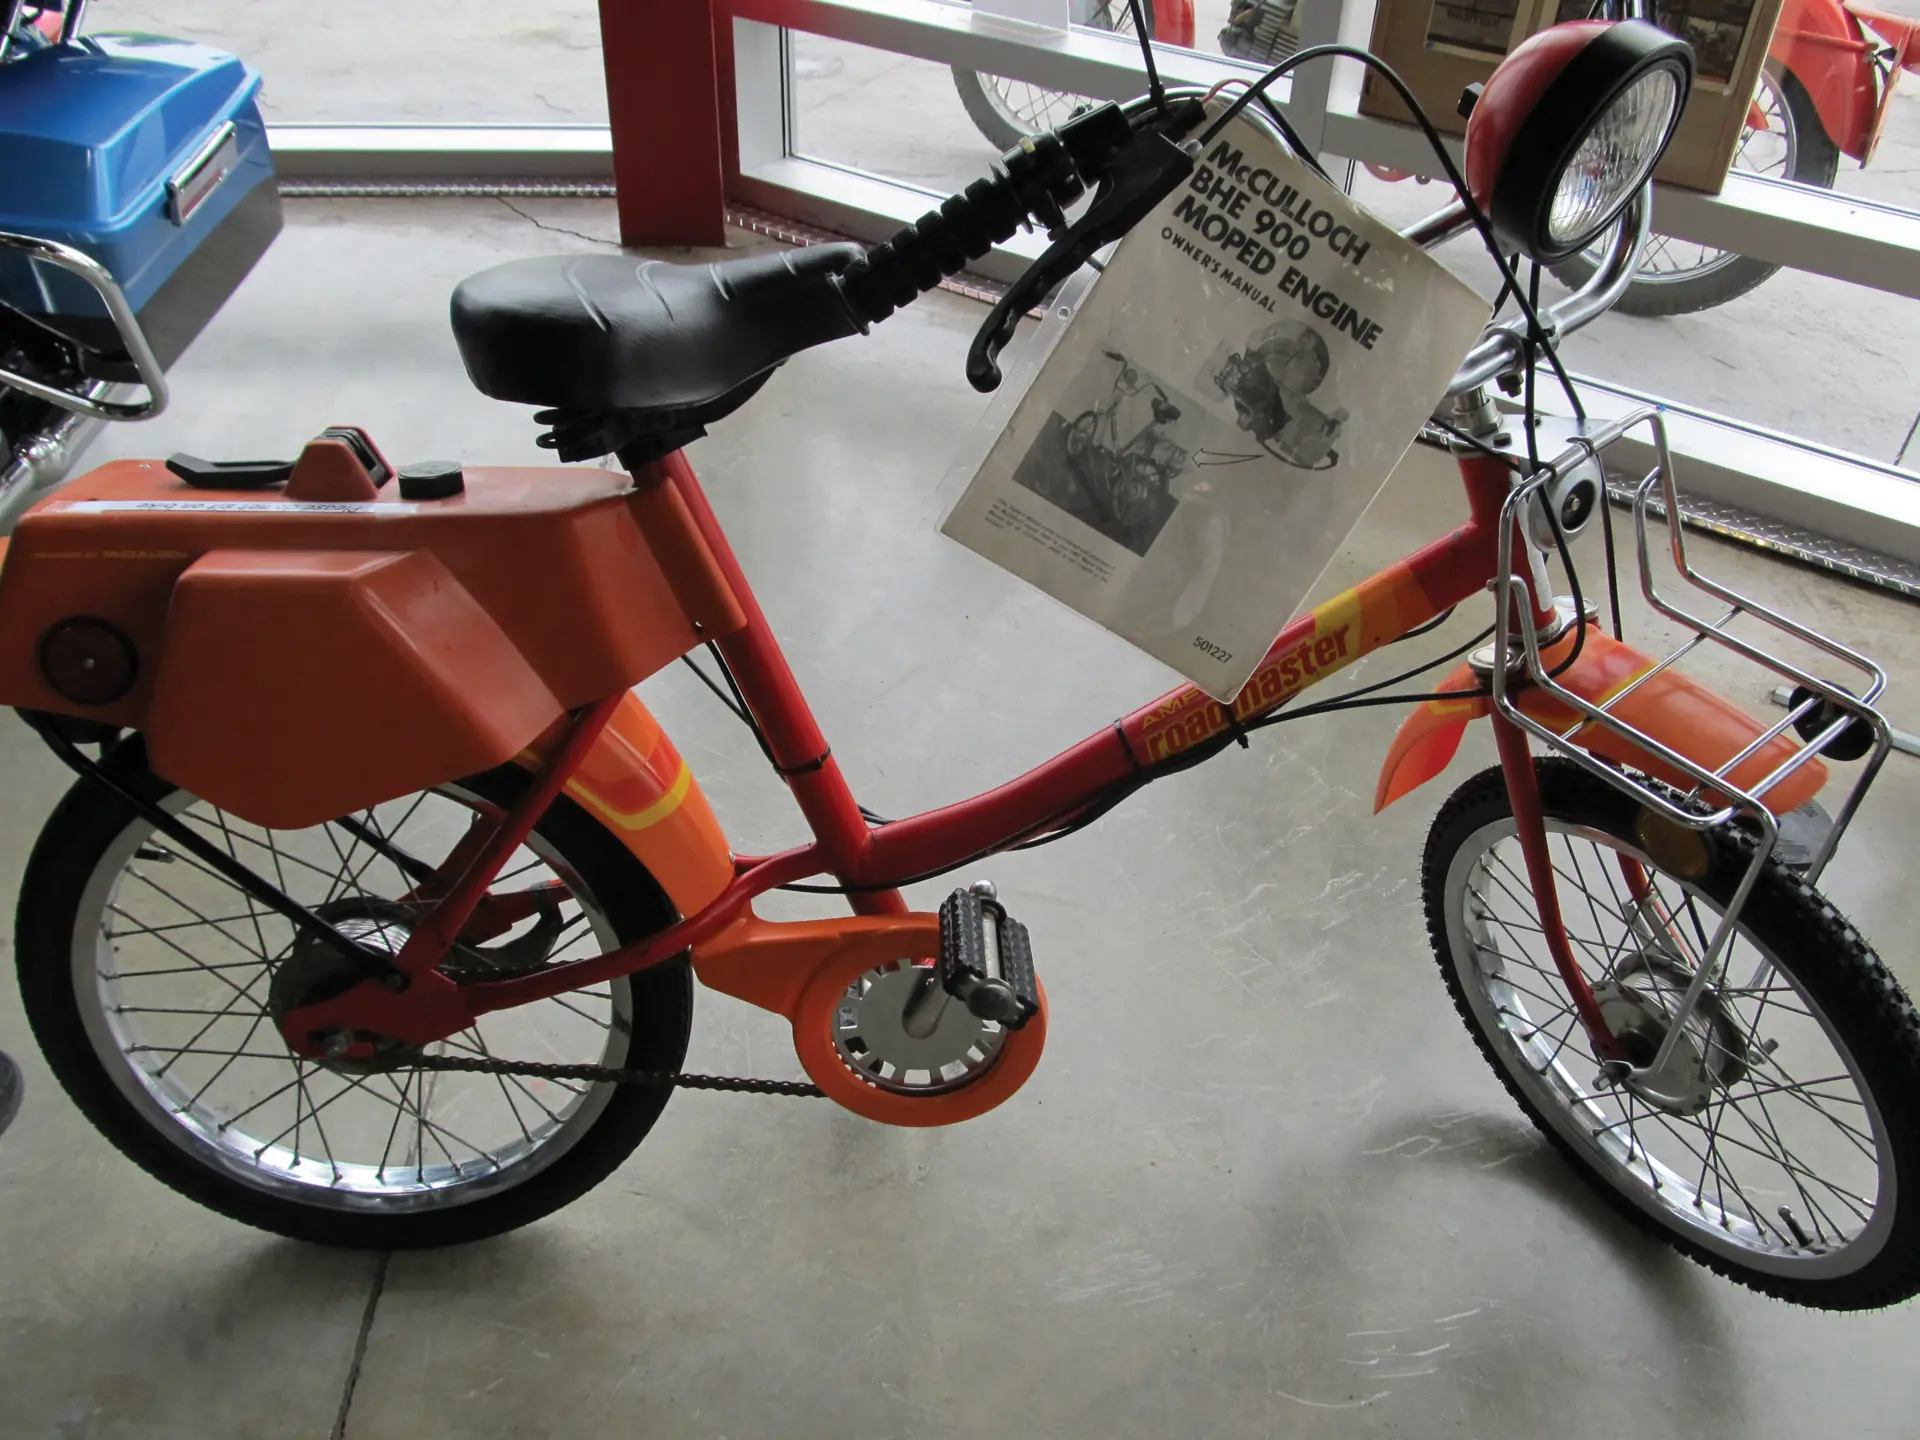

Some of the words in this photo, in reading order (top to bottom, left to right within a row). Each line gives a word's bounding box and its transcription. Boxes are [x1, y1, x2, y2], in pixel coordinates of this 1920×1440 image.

[1188, 163, 1252, 221] BHE
[1251, 209, 1311, 261] 900
[1206, 139, 1371, 266] McCULLOCH
[1160, 226, 1222, 274] OWNER'S
[1219, 268, 1277, 314] MANUAL
[1172, 193, 1277, 276] MOPED
[1276, 265, 1384, 351] ENGINE
[1192, 636, 1233, 664] 501227
